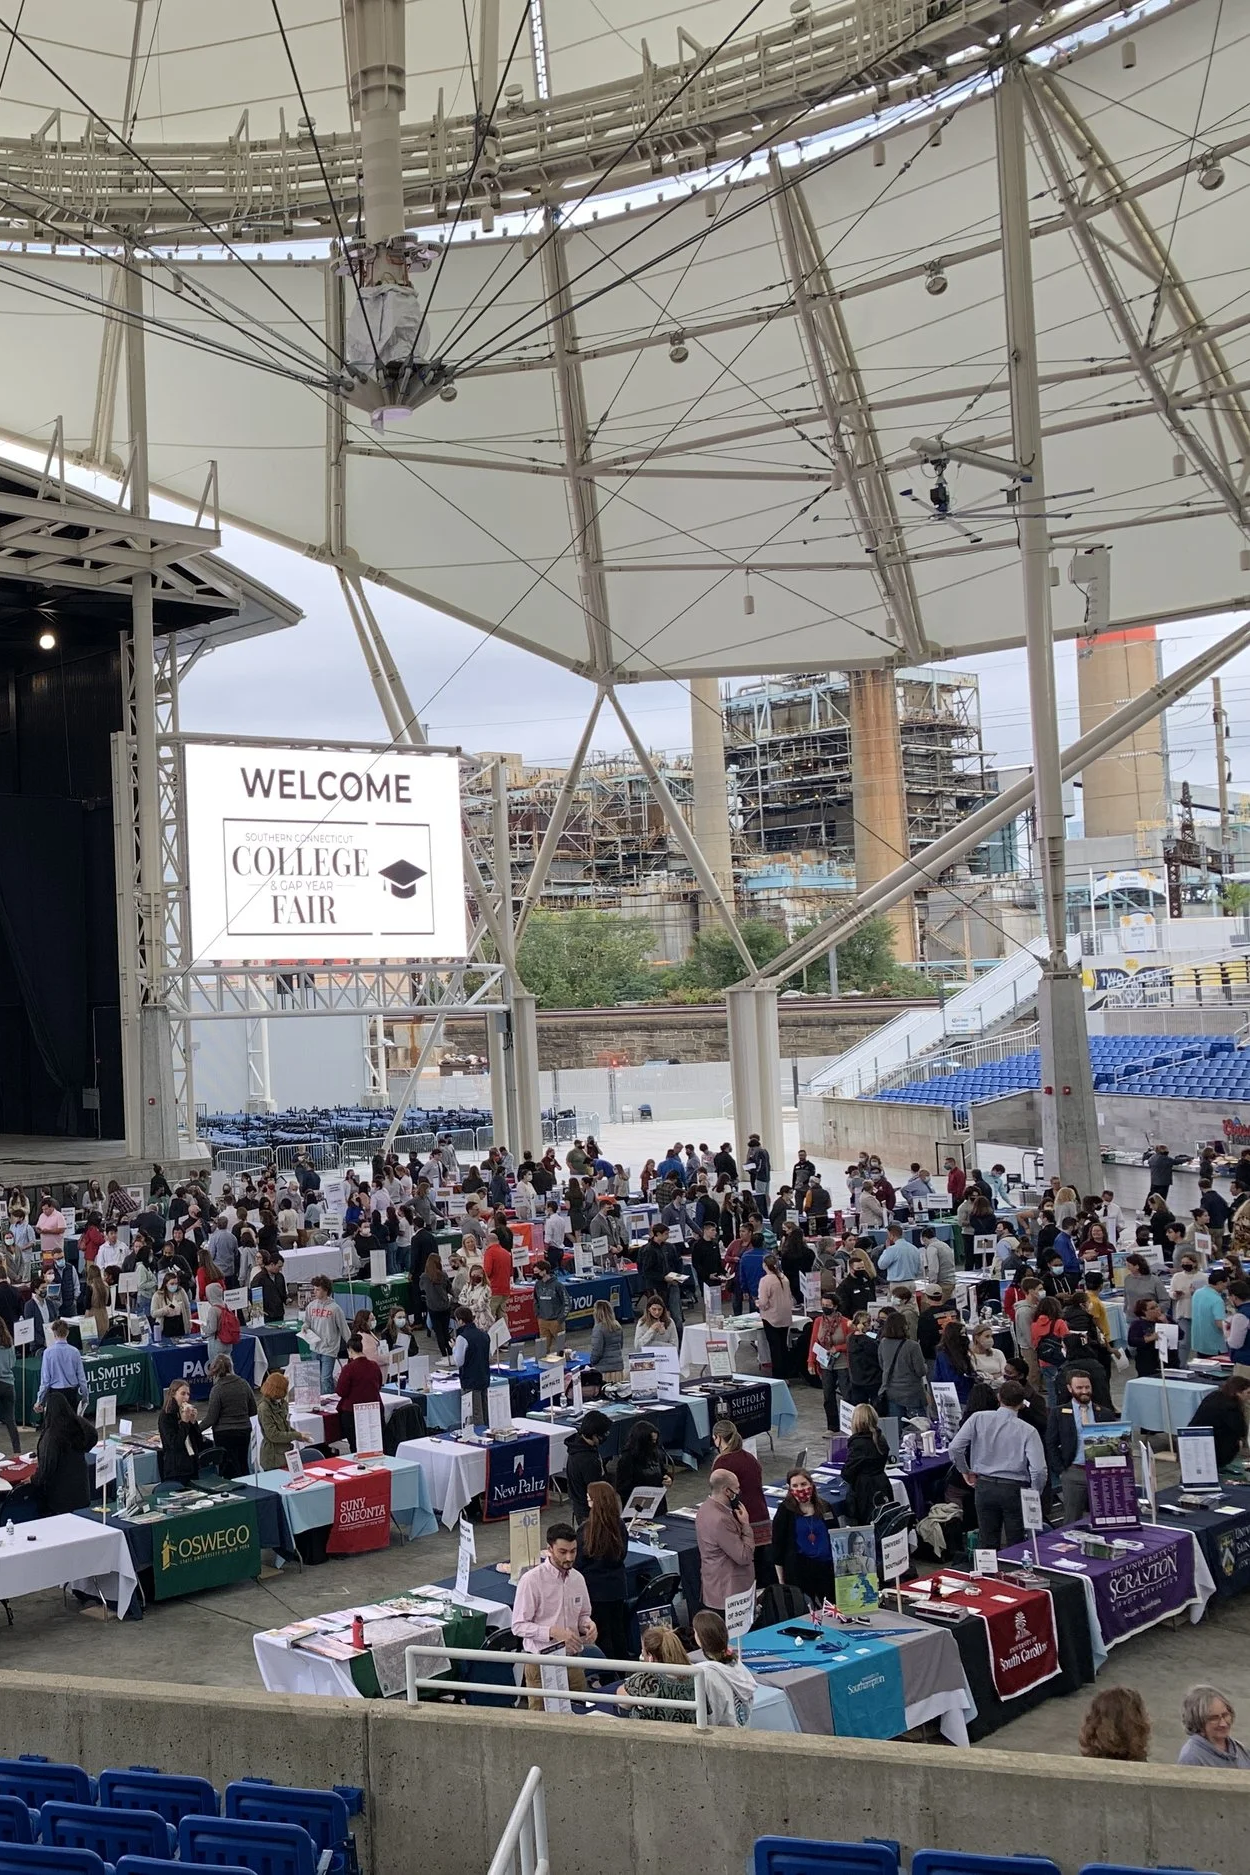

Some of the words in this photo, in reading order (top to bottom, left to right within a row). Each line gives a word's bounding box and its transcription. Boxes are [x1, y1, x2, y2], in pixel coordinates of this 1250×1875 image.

[240, 767, 412, 804] WELCOME
[245, 832, 293, 843] SOUTHERN
[294, 833, 354, 844] CONNECTICUT
[232, 845, 370, 878] COLLEGE
[280, 880, 304, 891] GAP
[305, 880, 333, 891] YEAR
[271, 894, 338, 924] FAIR
[311, 1308, 333, 1319] PREP
[732, 1391, 766, 1409] SUFFOLK
[732, 1402, 766, 1417] UNIVERSITY
[493, 1484, 518, 1501] New
[518, 1476, 546, 1494] Paltz
[340, 1497, 366, 1513] SUNY
[340, 1504, 386, 1524] ONEONTA
[179, 1525, 250, 1558] OSWEGO
[1109, 1566, 1124, 1578] THE
[1167, 1543, 1178, 1552] OF
[1109, 1551, 1178, 1603] SCRANTON
[727, 1620, 743, 1630] MAINE
[1000, 1655, 1021, 1672] South
[847, 1675, 885, 1695] Southampton
